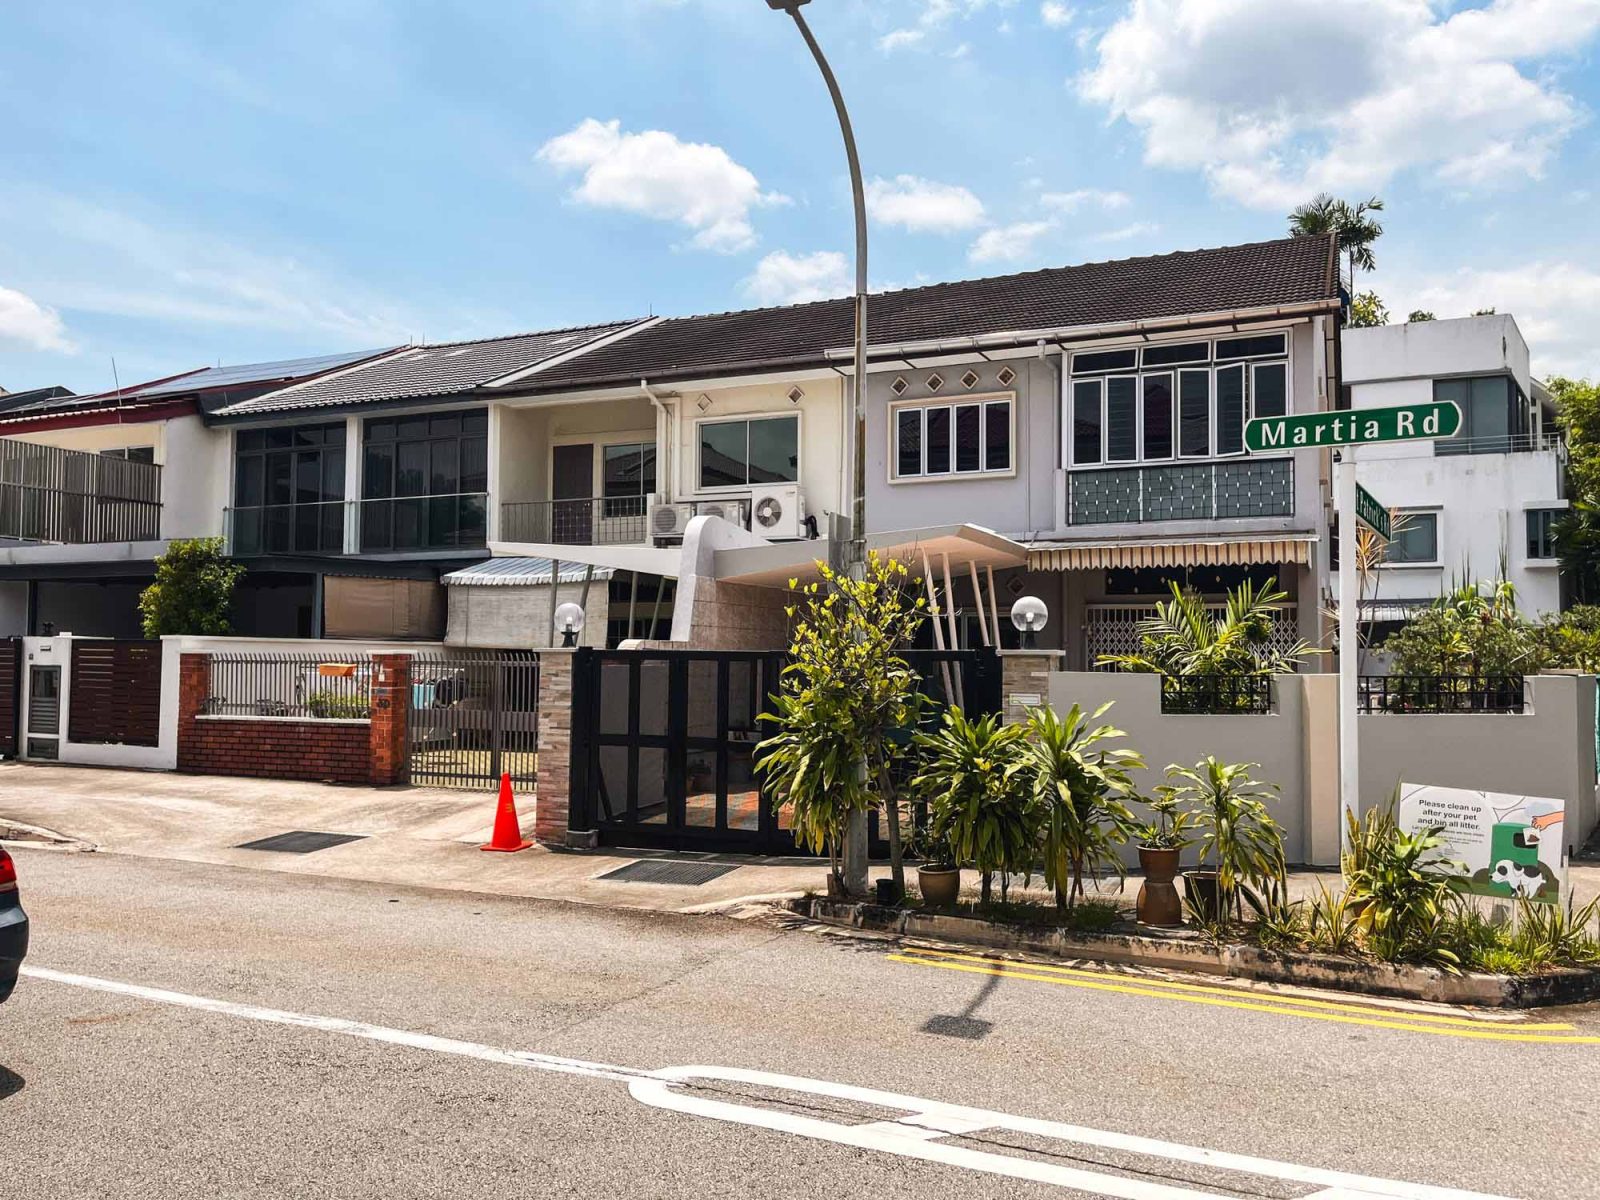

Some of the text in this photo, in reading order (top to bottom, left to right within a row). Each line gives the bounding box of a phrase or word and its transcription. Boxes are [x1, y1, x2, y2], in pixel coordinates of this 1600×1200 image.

[1262, 408, 1439, 446] Martia Rd
[1419, 800, 1445, 809] Please
[1447, 803, 1469, 811] clean
[1422, 809, 1441, 817] after
[1417, 817, 1432, 825] and
[1460, 822, 1480, 830] litter.
